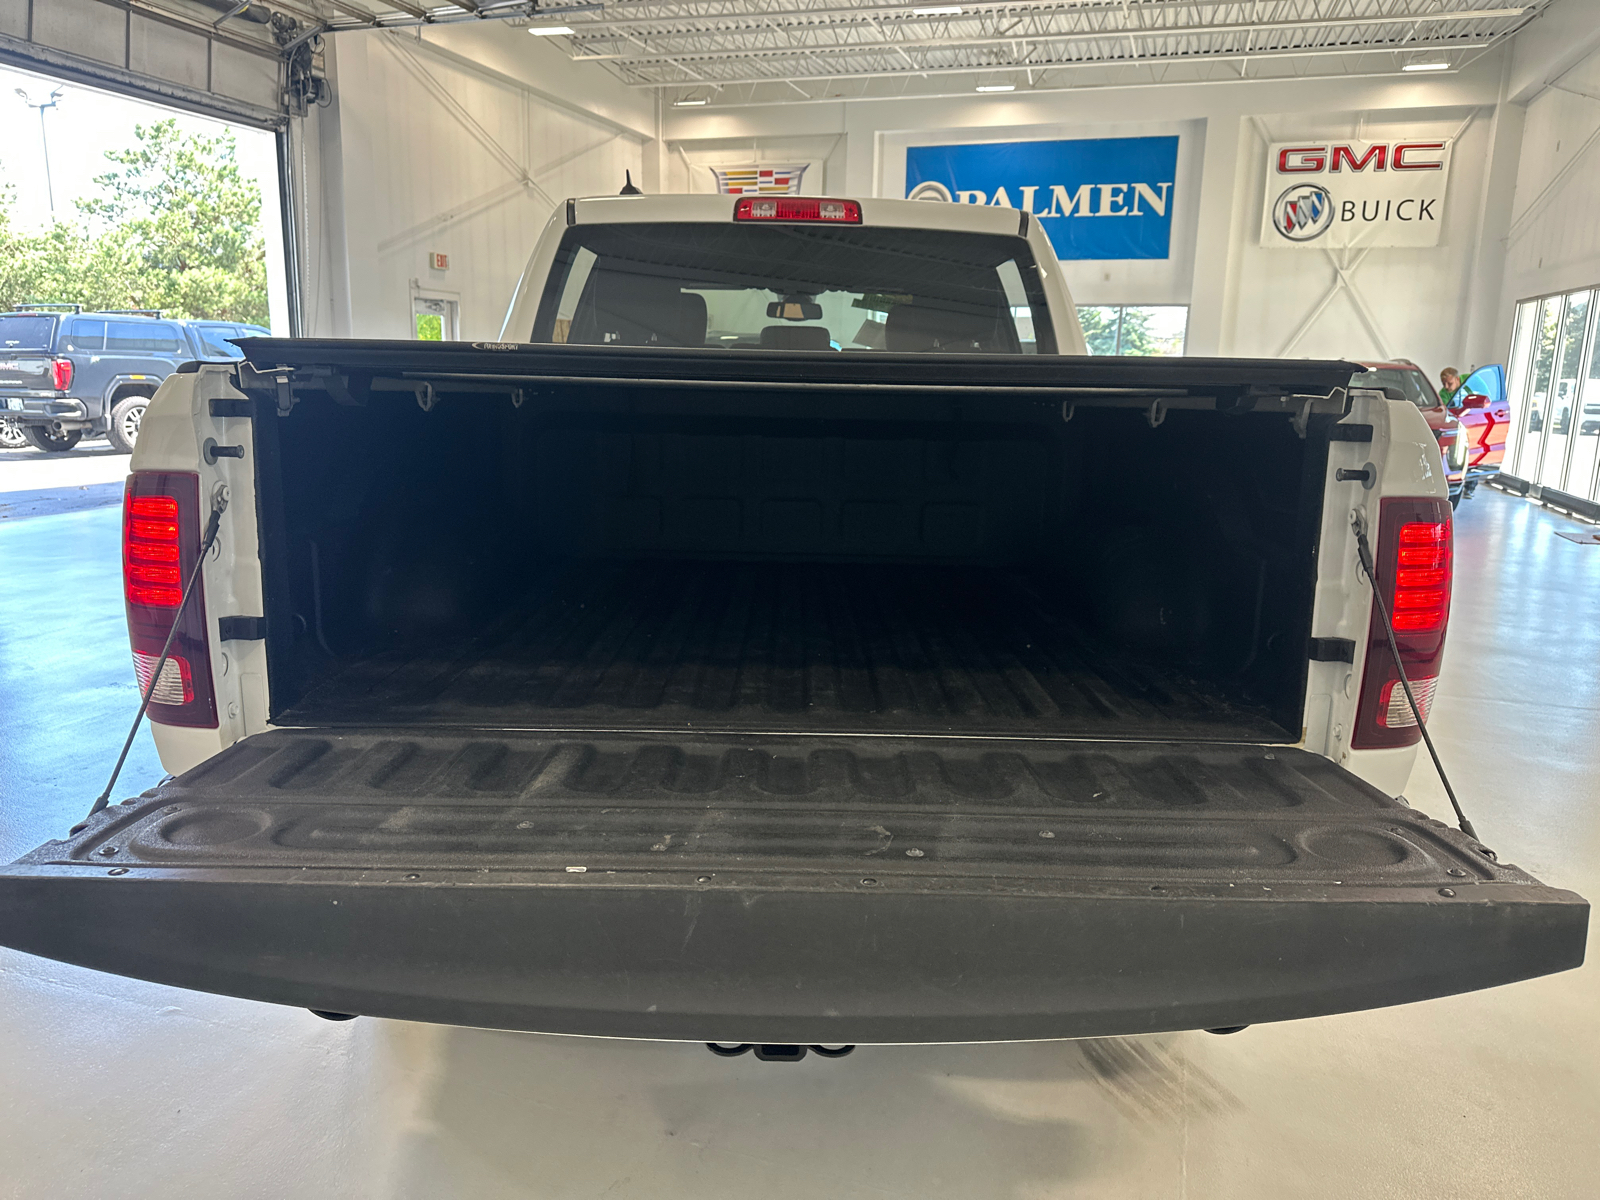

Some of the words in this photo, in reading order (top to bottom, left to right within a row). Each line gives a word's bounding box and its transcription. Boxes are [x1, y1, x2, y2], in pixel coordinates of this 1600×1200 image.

[1276, 141, 1446, 175] GMC
[956, 183, 1172, 217] PALMEN
[1341, 199, 1436, 222] BUICK
